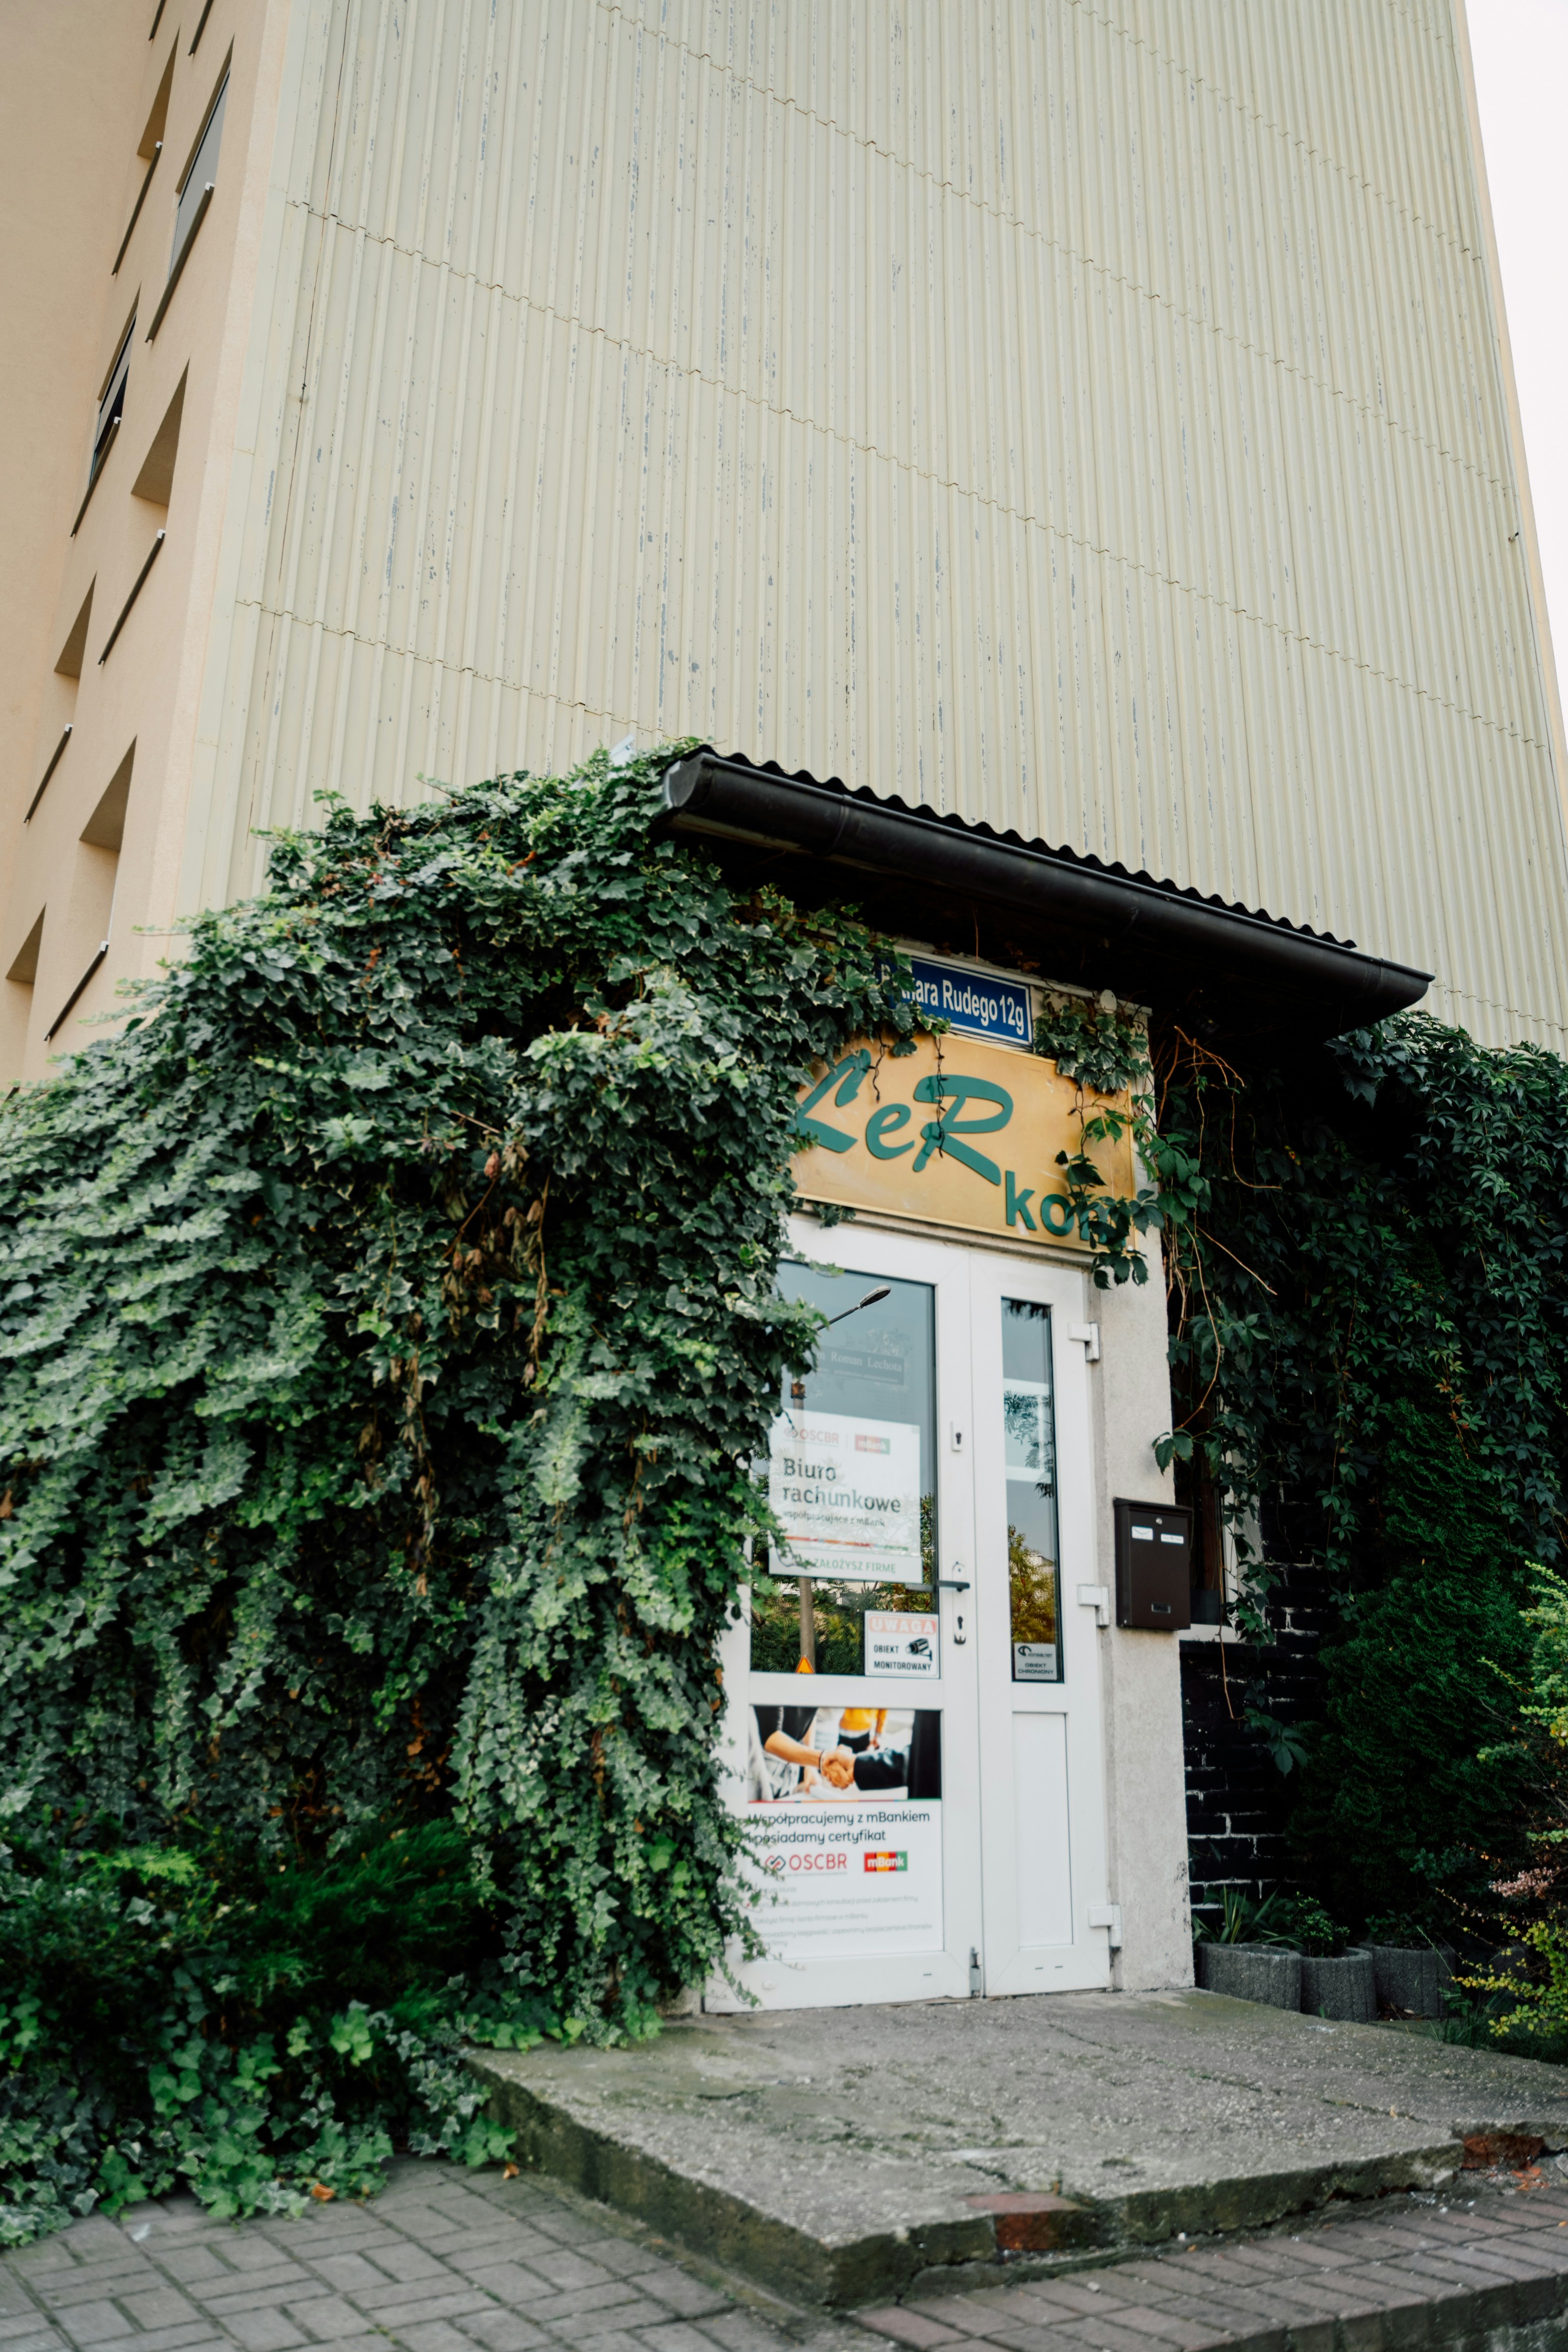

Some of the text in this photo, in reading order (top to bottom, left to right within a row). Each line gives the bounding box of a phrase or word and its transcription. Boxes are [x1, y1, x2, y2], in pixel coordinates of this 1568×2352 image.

[943, 979, 998, 1027] Rudego
[999, 995, 1024, 1036] 12g
[830, 1352, 863, 1366] Roman
[867, 1357, 902, 1372] Lechota
[799, 1429, 840, 1444] OSCBR
[858, 1440, 887, 1451] mBank
[783, 1457, 837, 1481] Biuro
[782, 1486, 901, 1513] rachunkowe
[856, 1517, 886, 1527] mBank
[866, 1562, 896, 1574] FIRMĘ
[872, 1618, 934, 1633] UWAGA
[873, 1645, 899, 1654] OBIEKT
[873, 1660, 932, 1671] MONITOROWANY
[857, 1815, 863, 1823] z
[866, 1809, 930, 1823] mBankiem
[754, 1831, 825, 1848] posiadamy
[828, 1829, 886, 1845] certyfikat
[789, 1853, 904, 1871] OSCBR mBank
